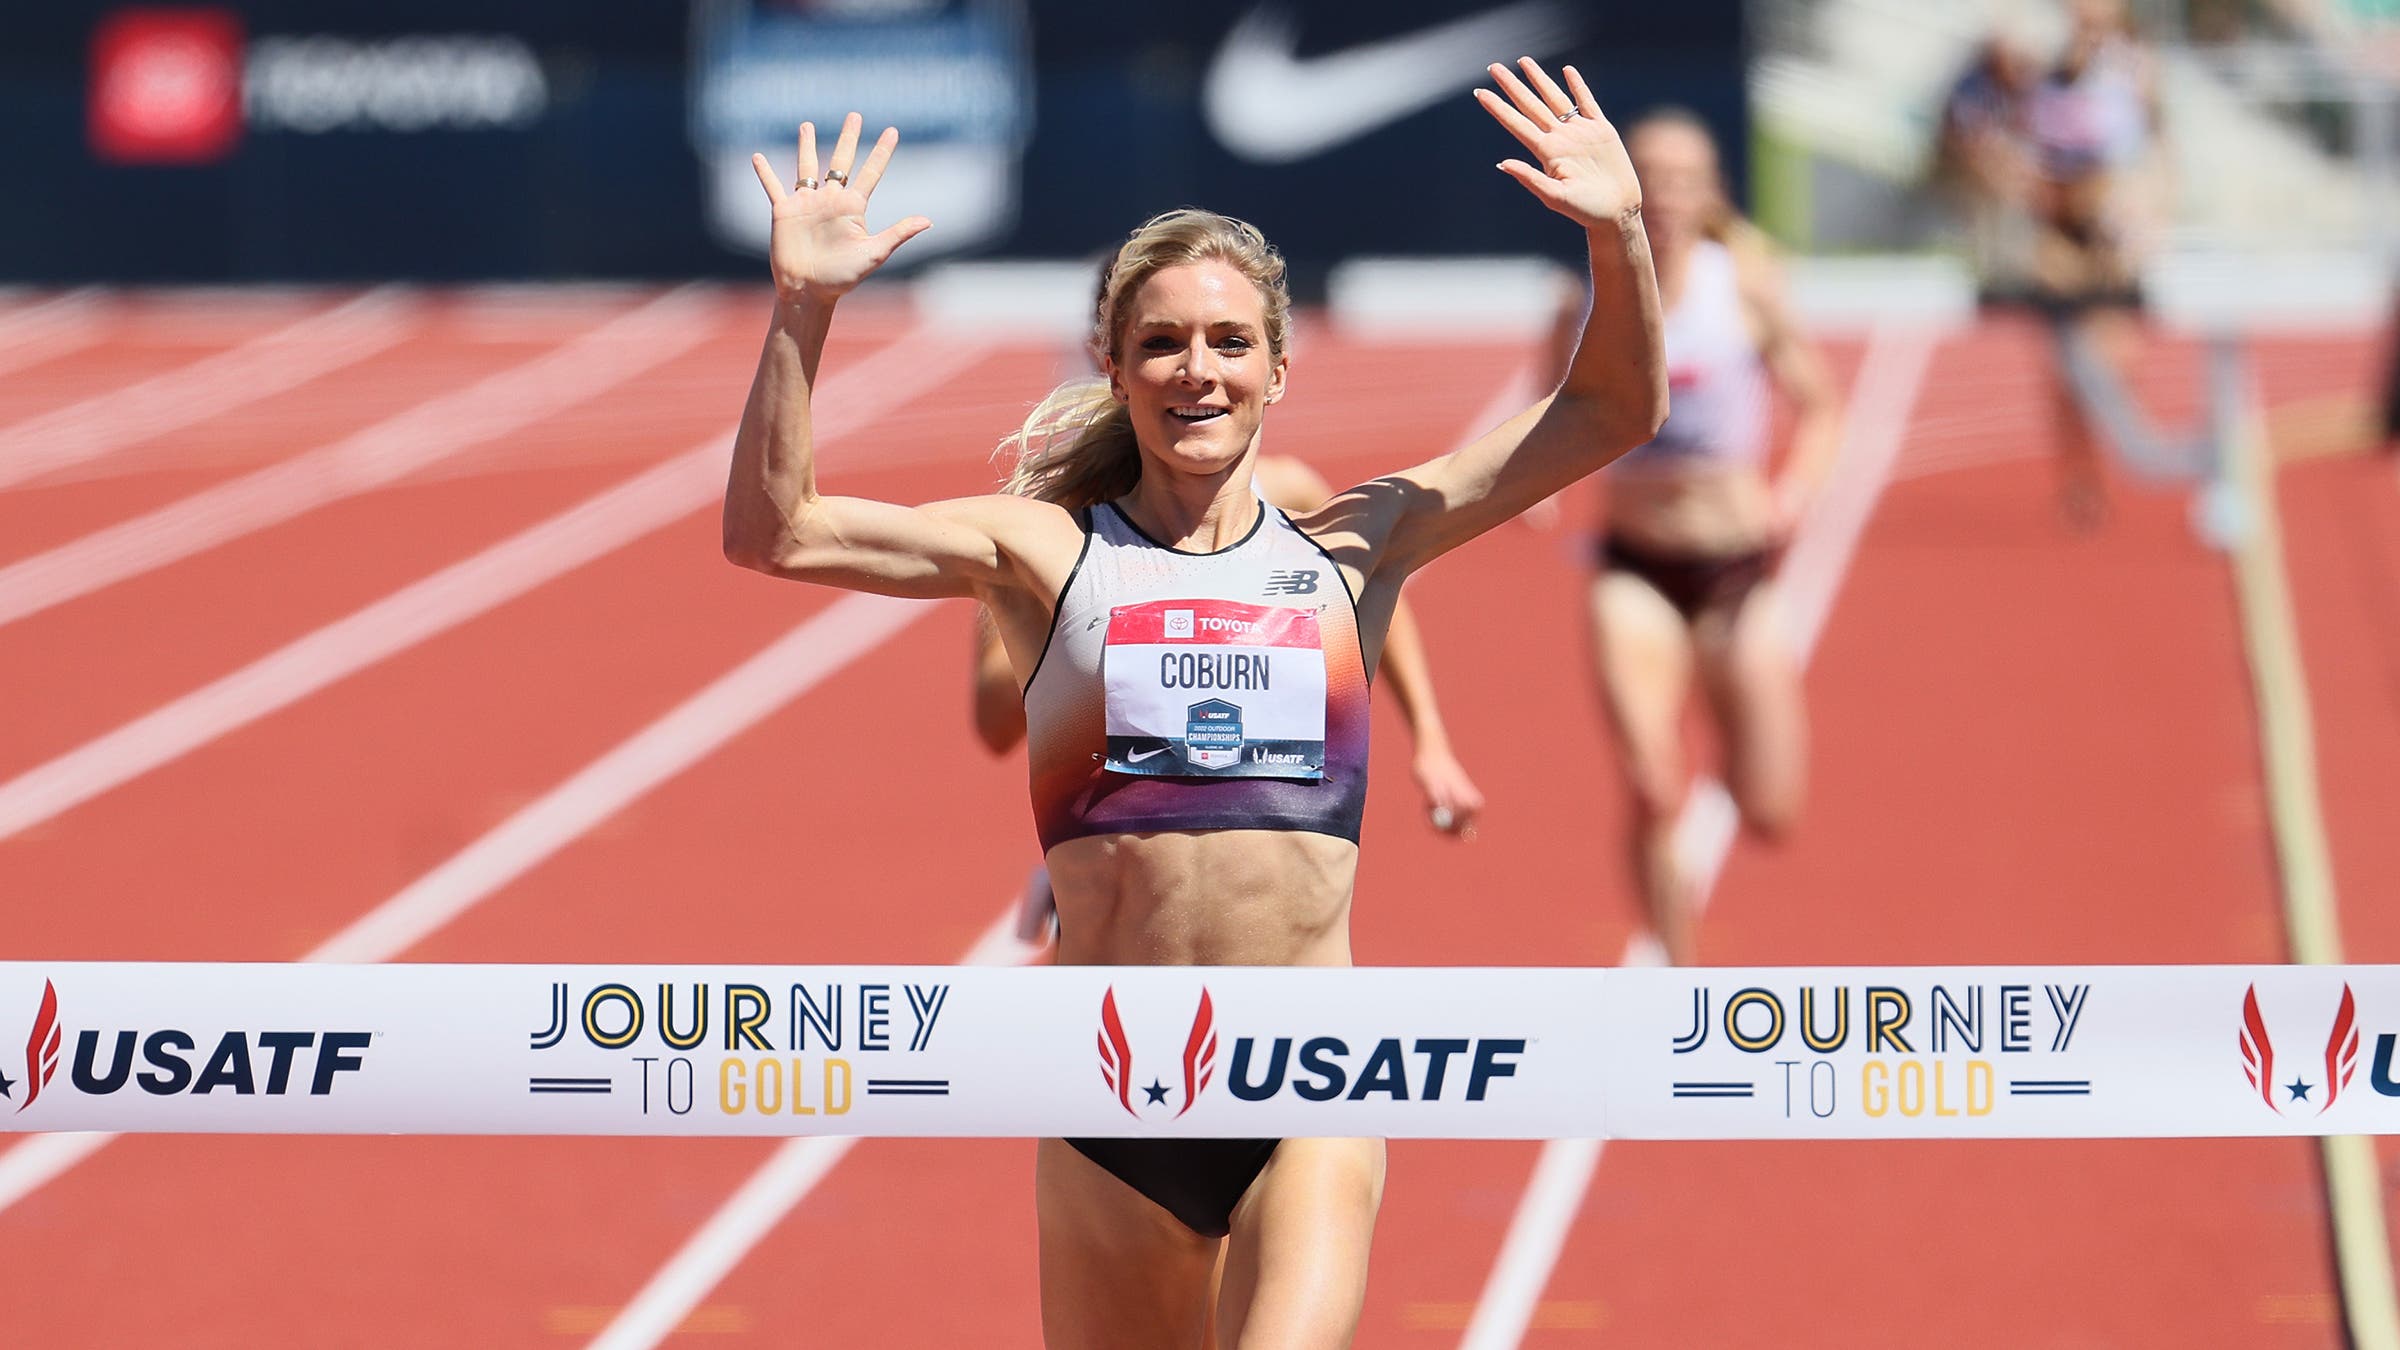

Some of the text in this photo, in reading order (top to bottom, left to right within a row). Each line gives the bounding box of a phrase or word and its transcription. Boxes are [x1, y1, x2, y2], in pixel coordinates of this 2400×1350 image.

[1200, 617, 1263, 634] TOYOTA
[1161, 652, 1270, 690] COBURN
[1188, 733, 1241, 742] CHAMPIONSHIPS
[1268, 754, 1304, 764] USATF
[530, 982, 950, 1051] JOURNEY
[1672, 984, 2092, 1054] JOURNEY
[71, 1029, 372, 1096] USATF
[632, 1057, 853, 1116] TO GOLD
[1227, 1036, 1526, 1101] USATF
[1775, 1060, 1994, 1118] TO GOLD
